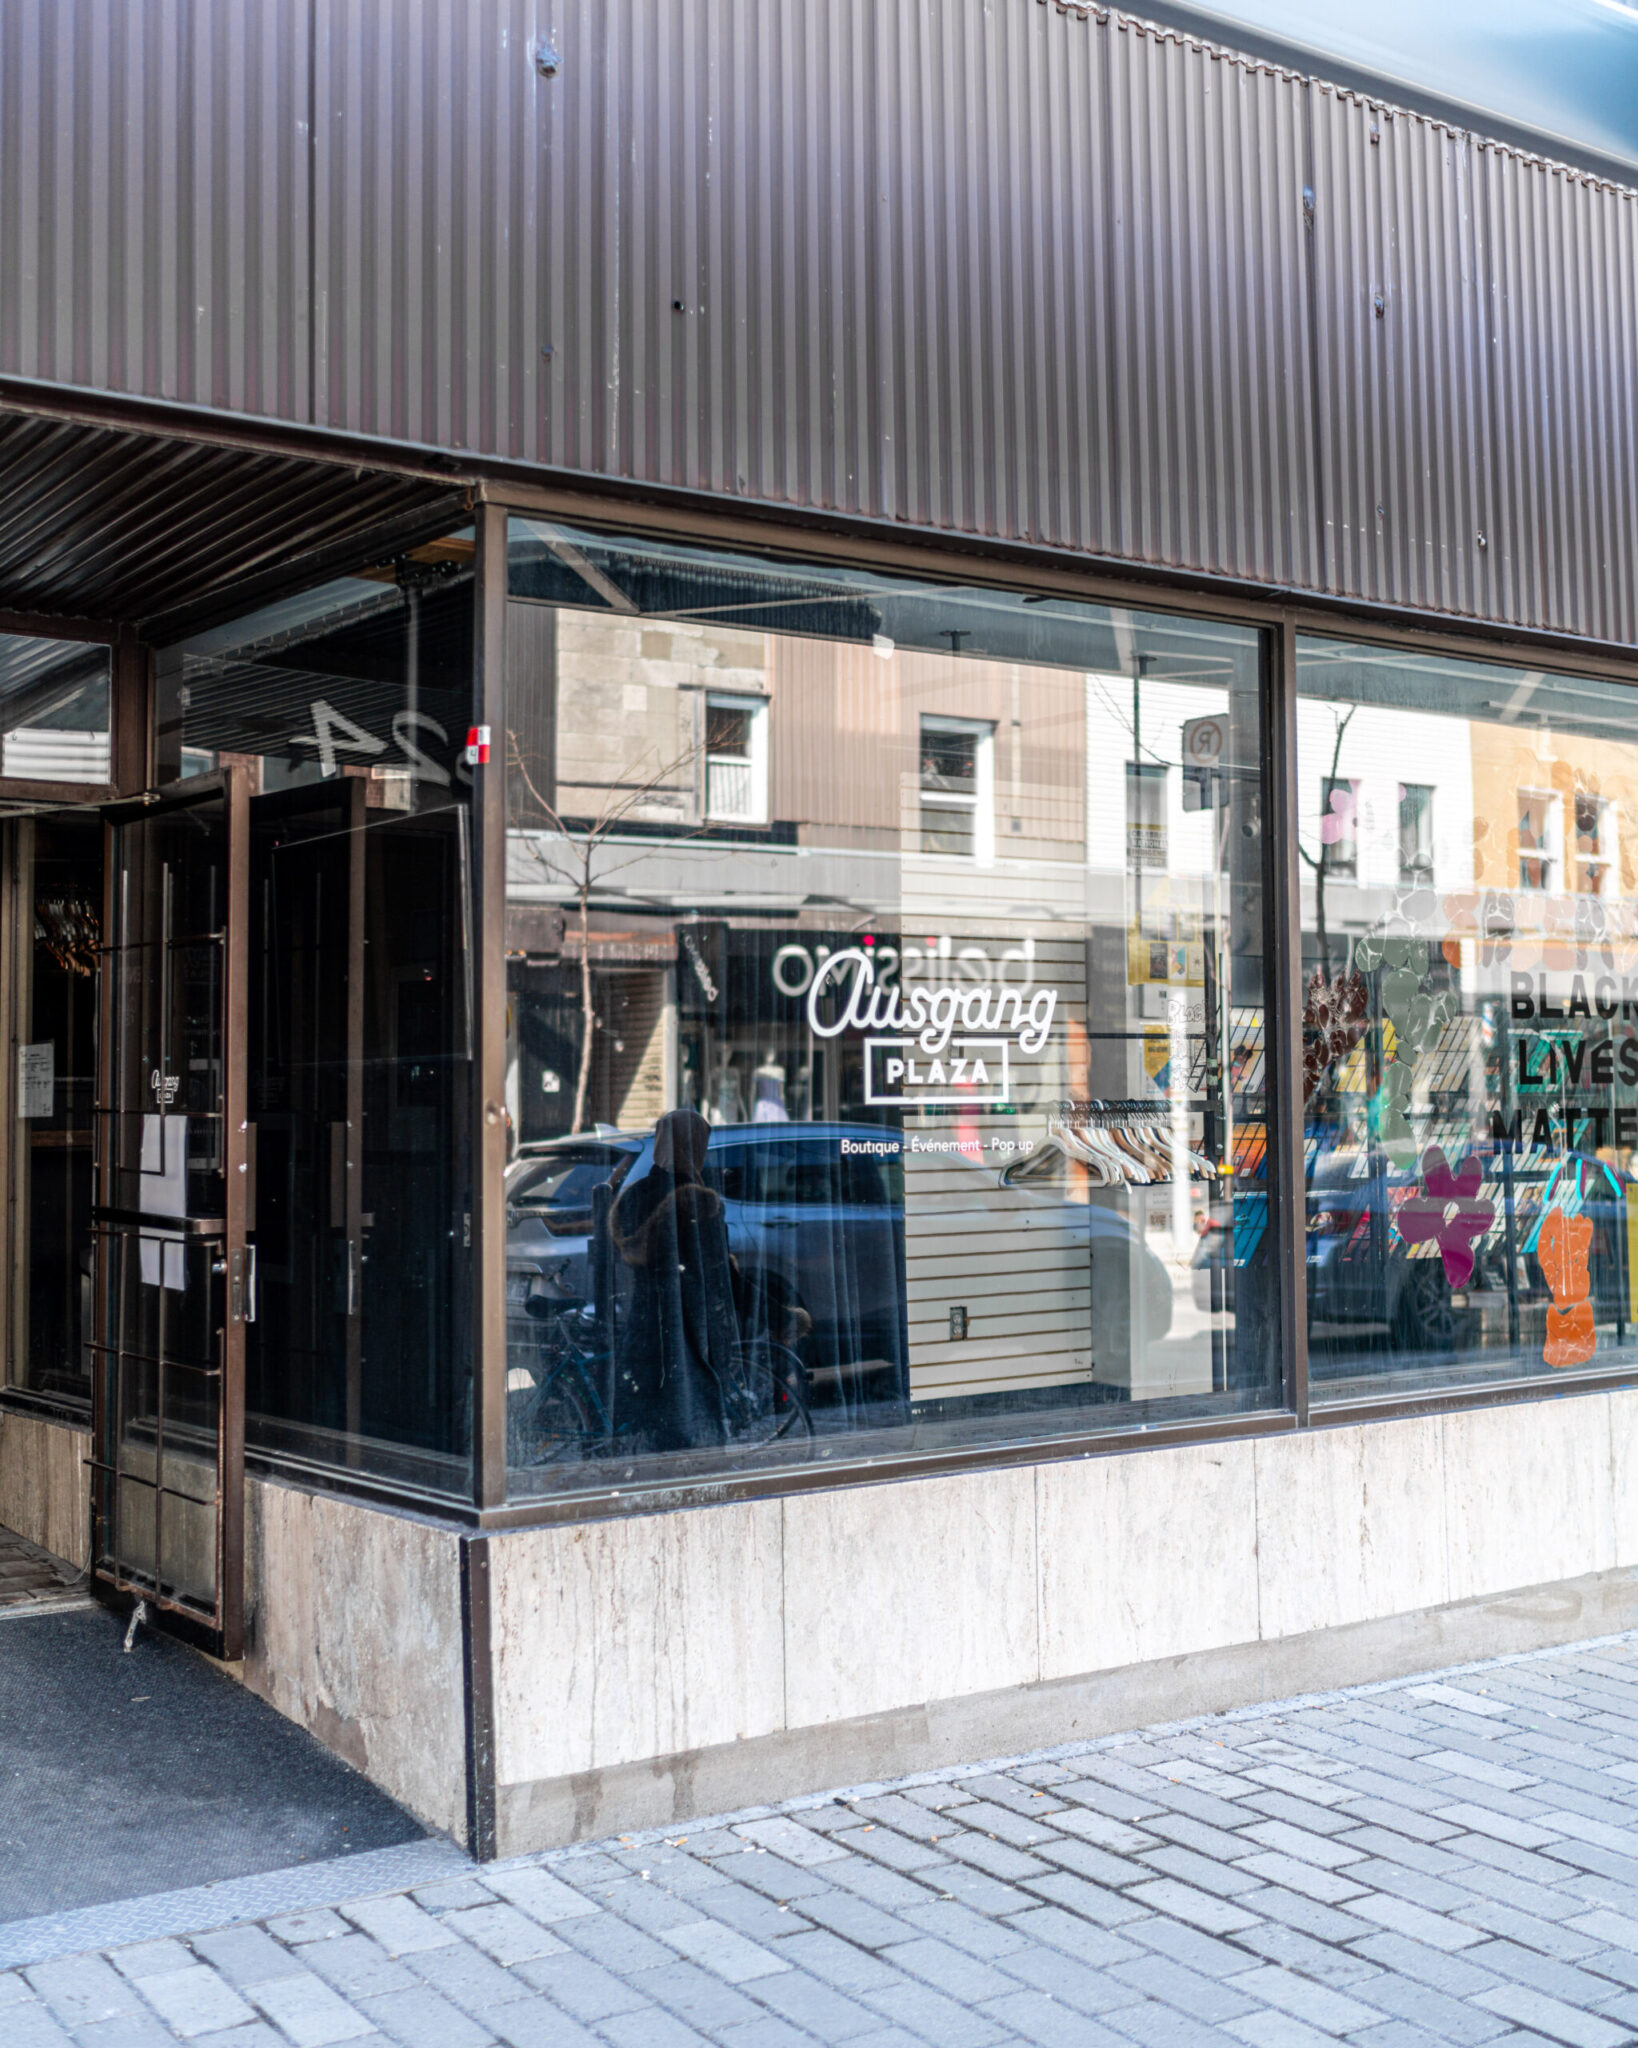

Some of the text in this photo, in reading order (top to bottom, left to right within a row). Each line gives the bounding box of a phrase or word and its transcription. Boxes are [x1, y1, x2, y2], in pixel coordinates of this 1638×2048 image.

[808, 949, 1058, 1053] Ausgang
[887, 1058, 989, 1083] PLAZA
[1519, 1038, 1638, 1086] LIVES
[841, 1139, 899, 1156] Boutique
[911, 1136, 980, 1152] Événement
[991, 1137, 1014, 1153] Pop
[1018, 1142, 1034, 1154] up
